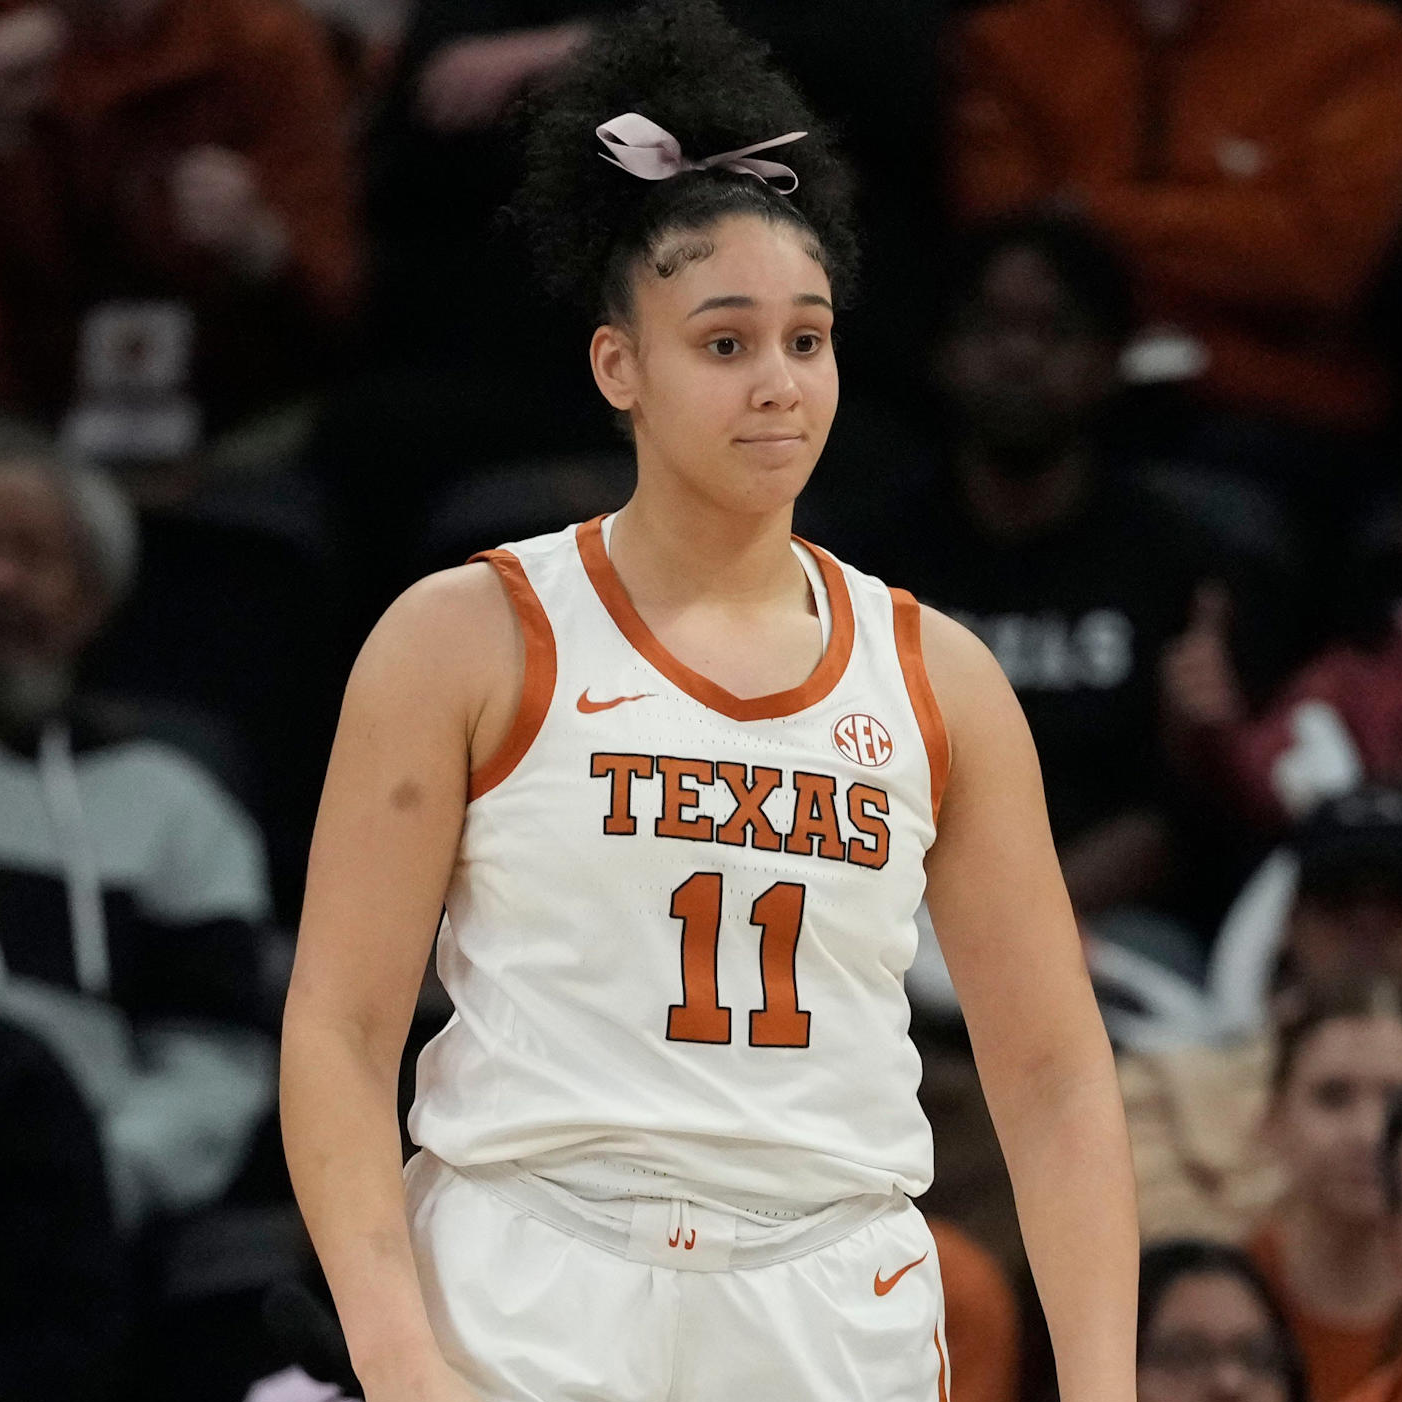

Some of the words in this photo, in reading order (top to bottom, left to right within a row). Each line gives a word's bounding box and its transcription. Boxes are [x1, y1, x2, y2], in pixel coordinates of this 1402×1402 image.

[835, 714, 892, 767] SEC
[590, 752, 891, 870] TEXAS
[665, 871, 812, 1049] 11
